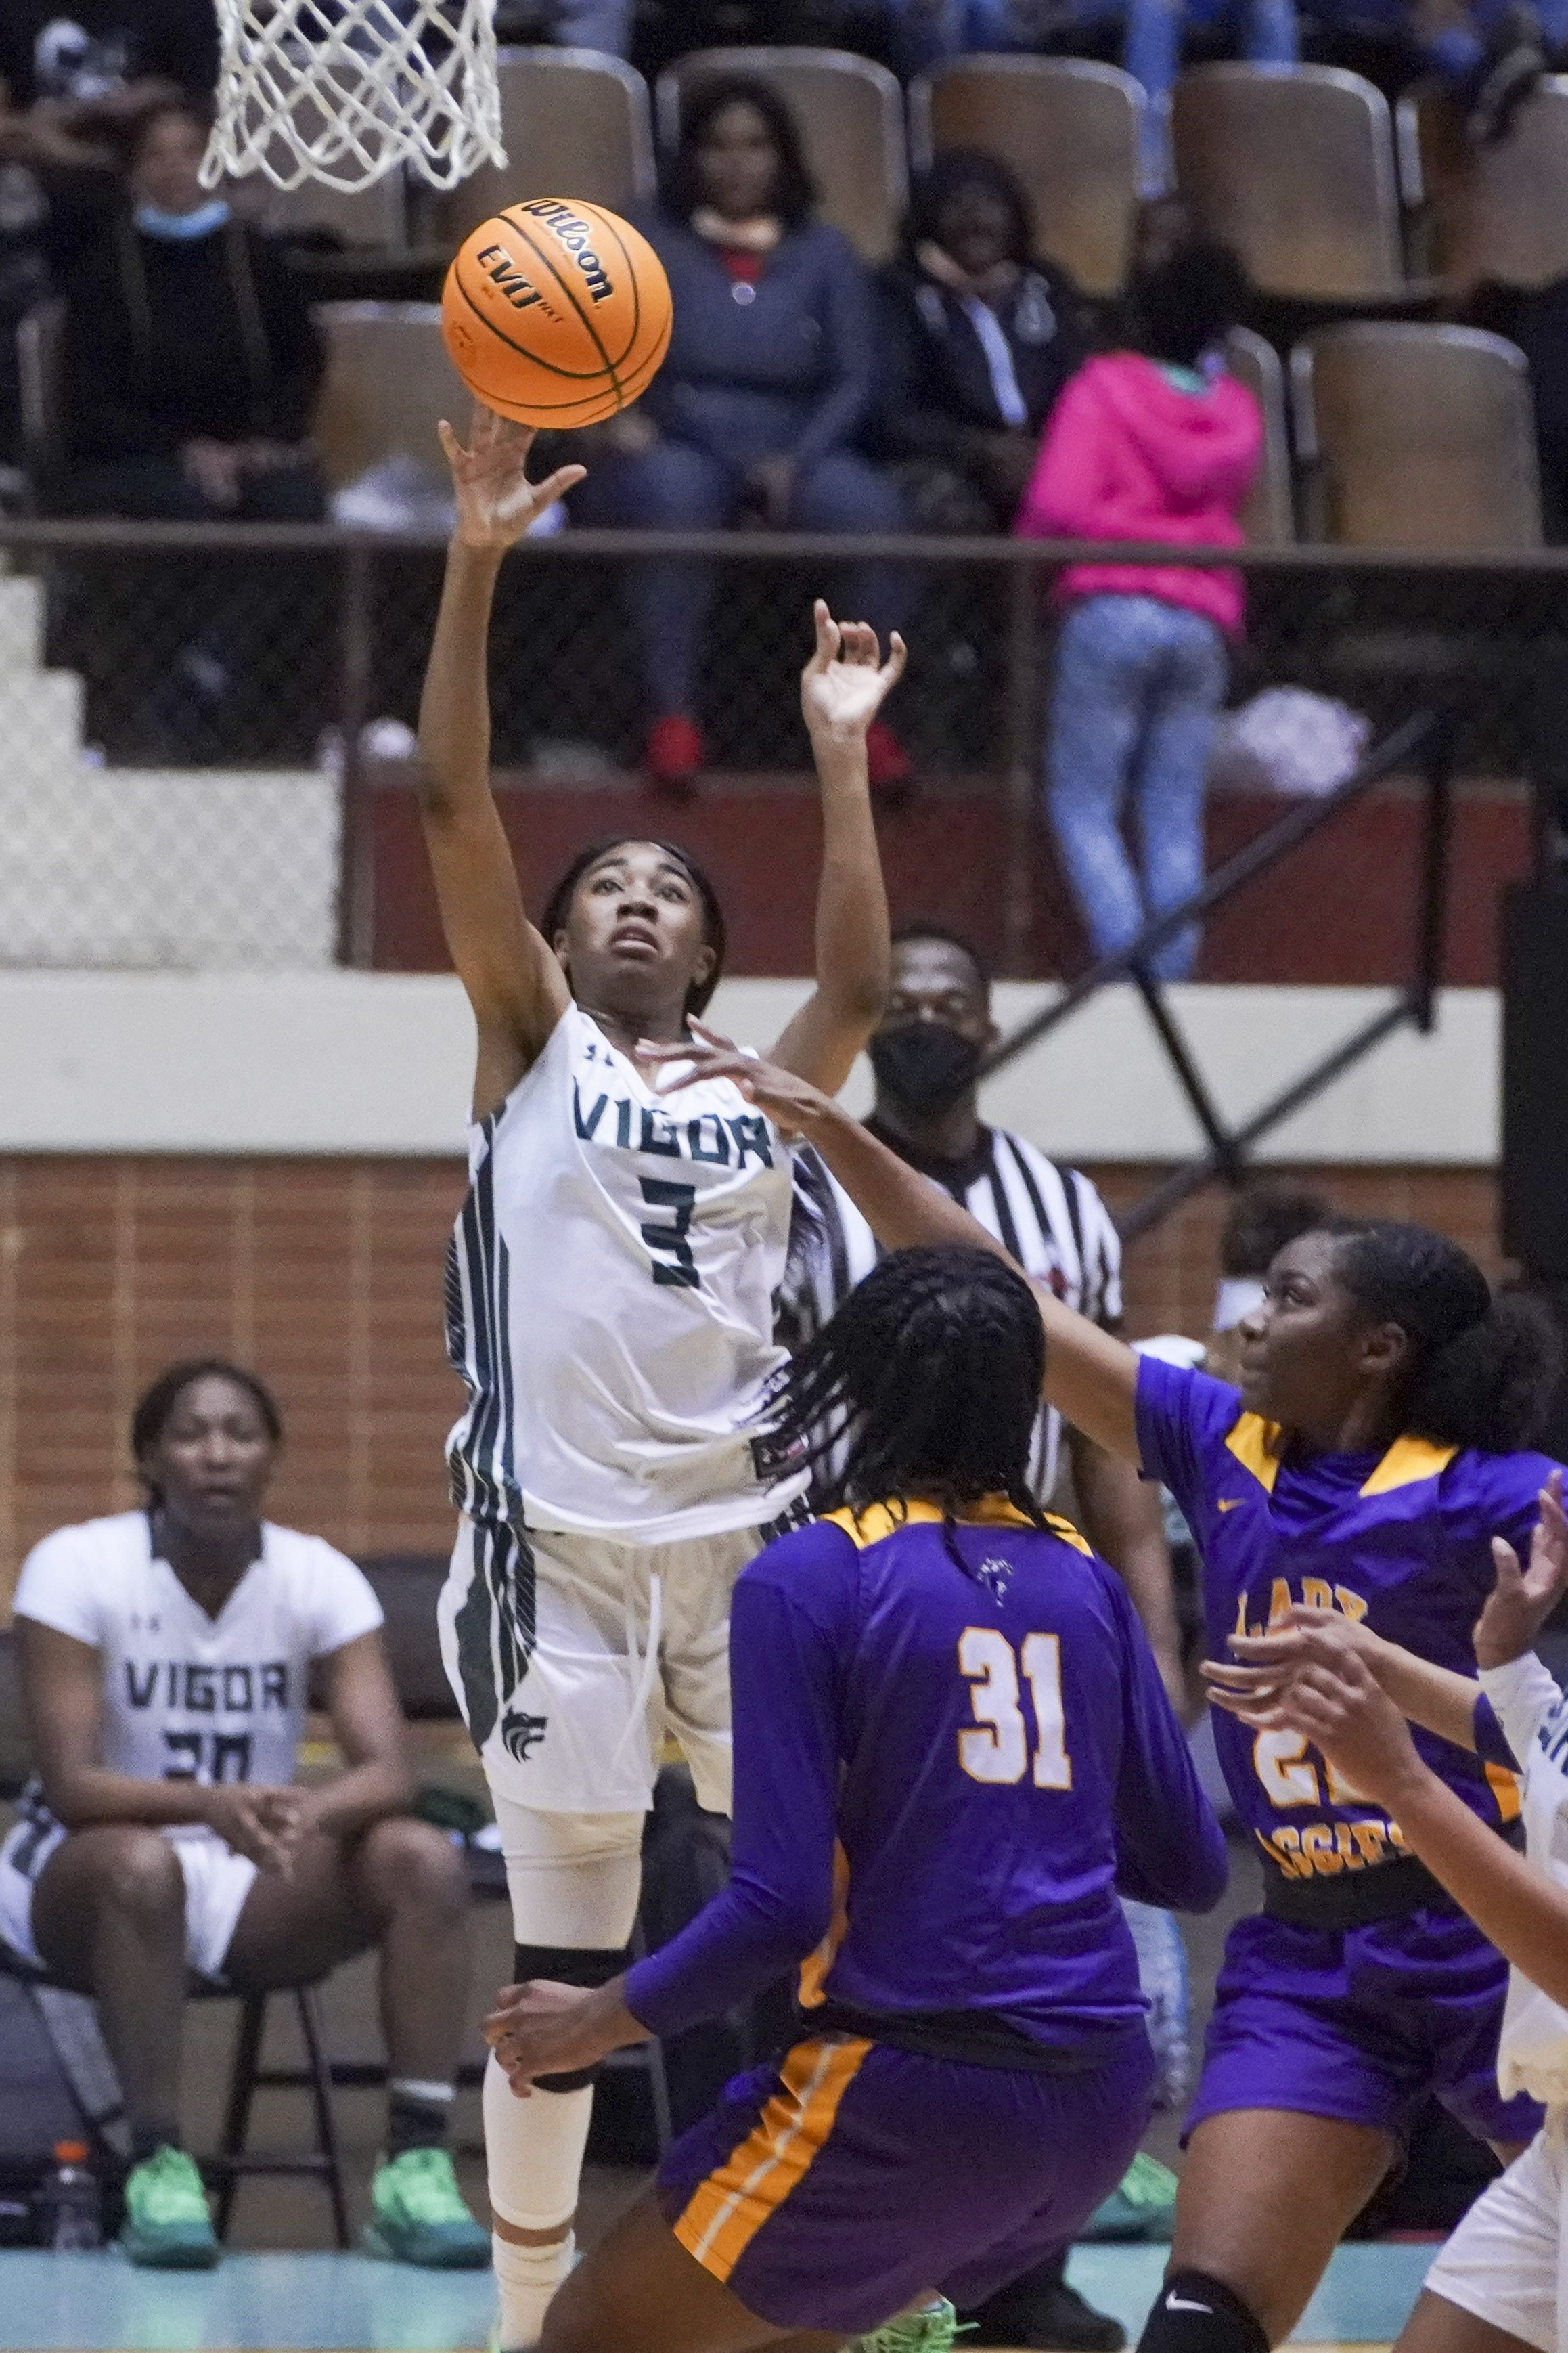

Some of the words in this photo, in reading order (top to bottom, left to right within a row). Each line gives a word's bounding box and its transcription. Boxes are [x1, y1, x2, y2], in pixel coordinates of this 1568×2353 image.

[477, 244, 543, 309] EVO
[521, 199, 614, 303] Wilson
[573, 1075, 774, 1170] VIGOR
[638, 1175, 700, 1288] 3
[125, 1658, 287, 1714] VIGOR
[958, 1626, 1073, 1790] 31
[1253, 1726, 1384, 1807] 2
